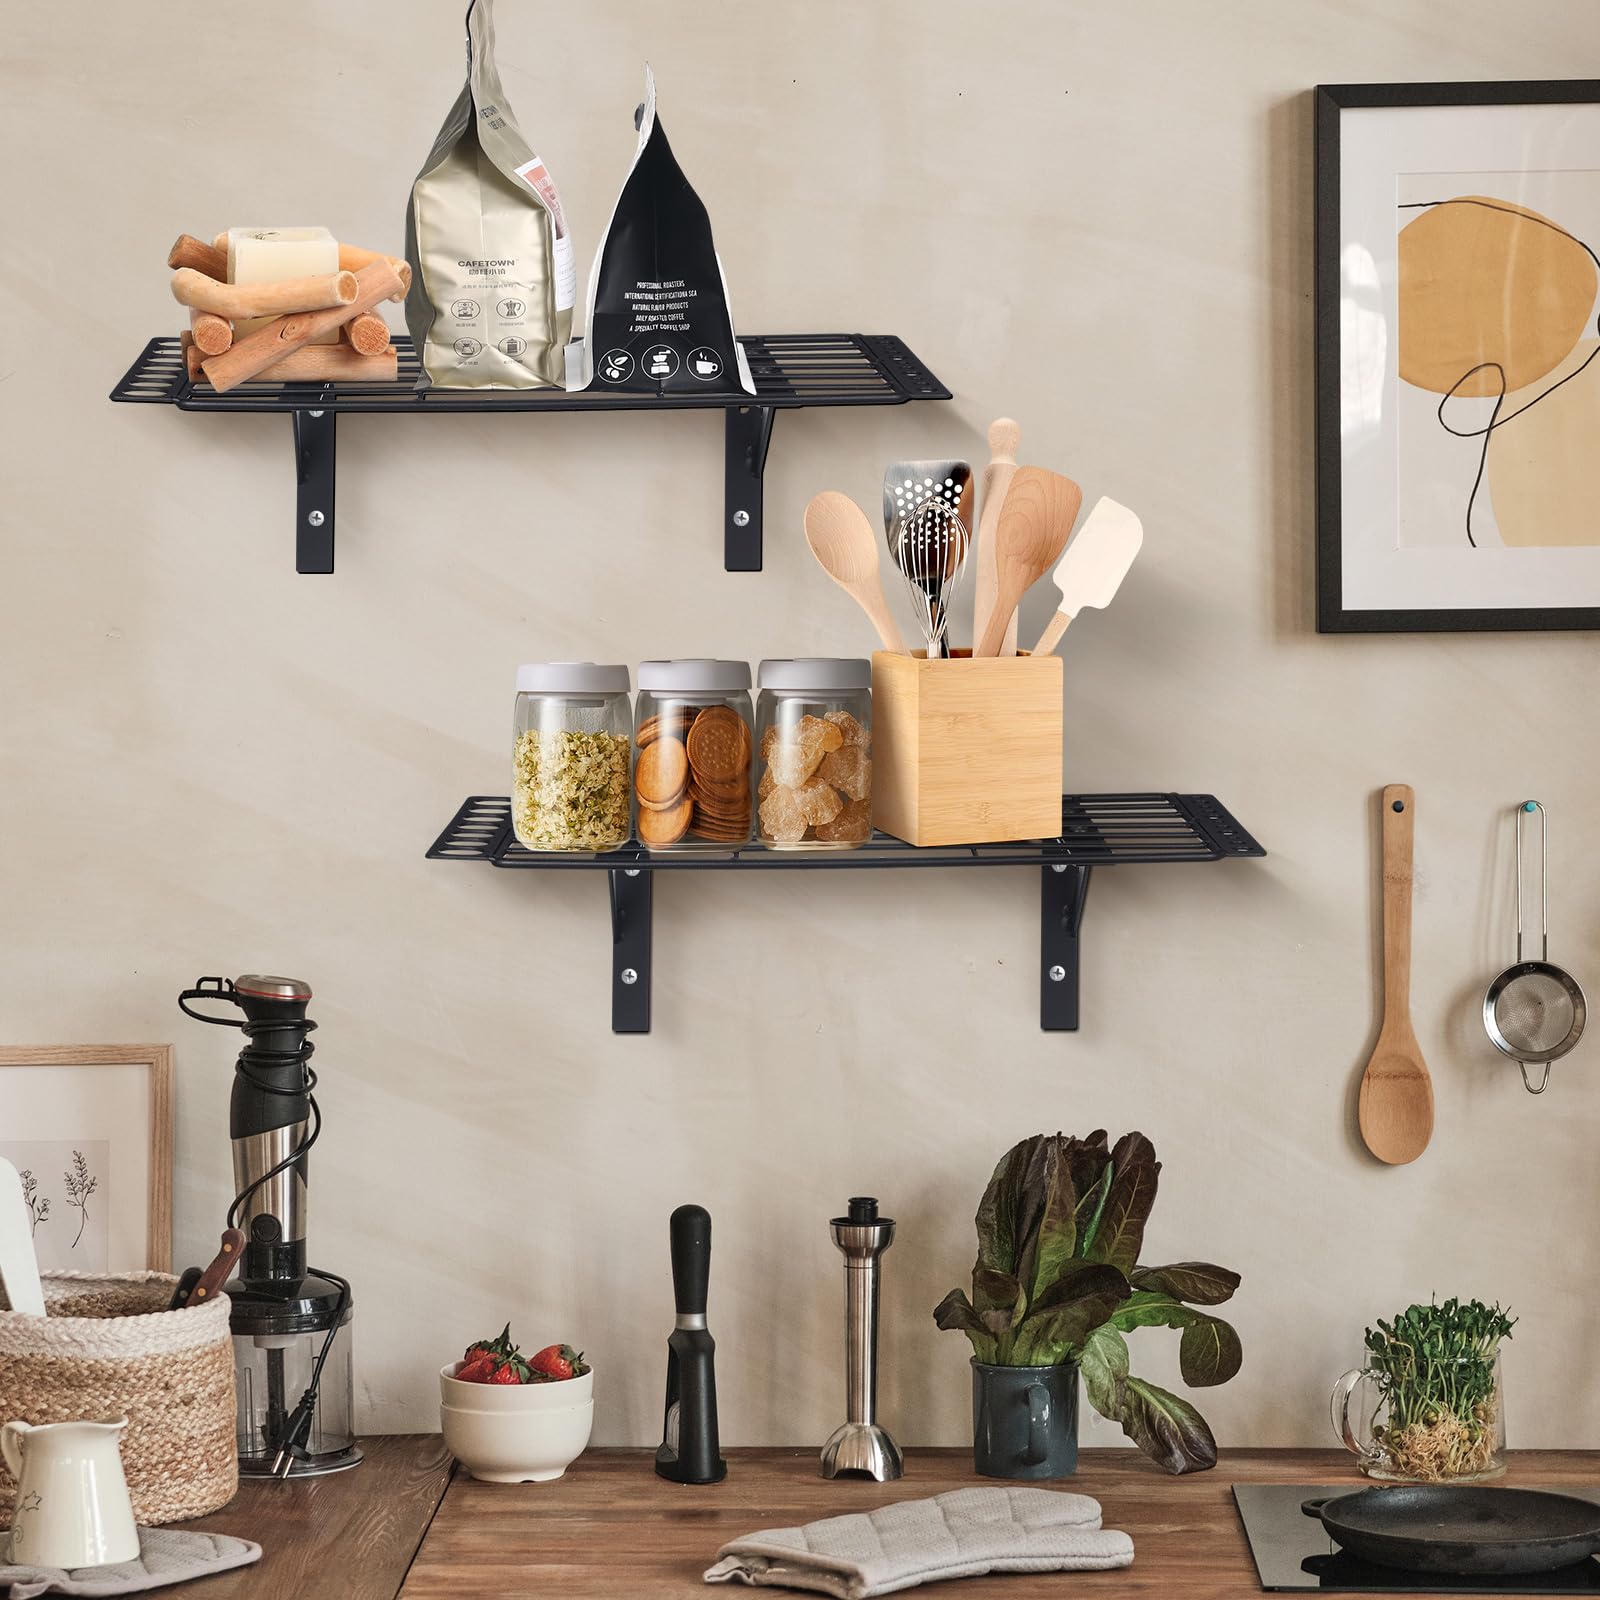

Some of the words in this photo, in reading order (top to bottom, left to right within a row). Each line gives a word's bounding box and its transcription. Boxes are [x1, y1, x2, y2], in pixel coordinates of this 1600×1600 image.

[663, 280, 685, 288] ROASTERS
[666, 301, 689, 310] PRODUCTS
[668, 313, 685, 321] COFFEE
[634, 324, 658, 332] SPECIALTY
[659, 323, 678, 331] COFFEE
